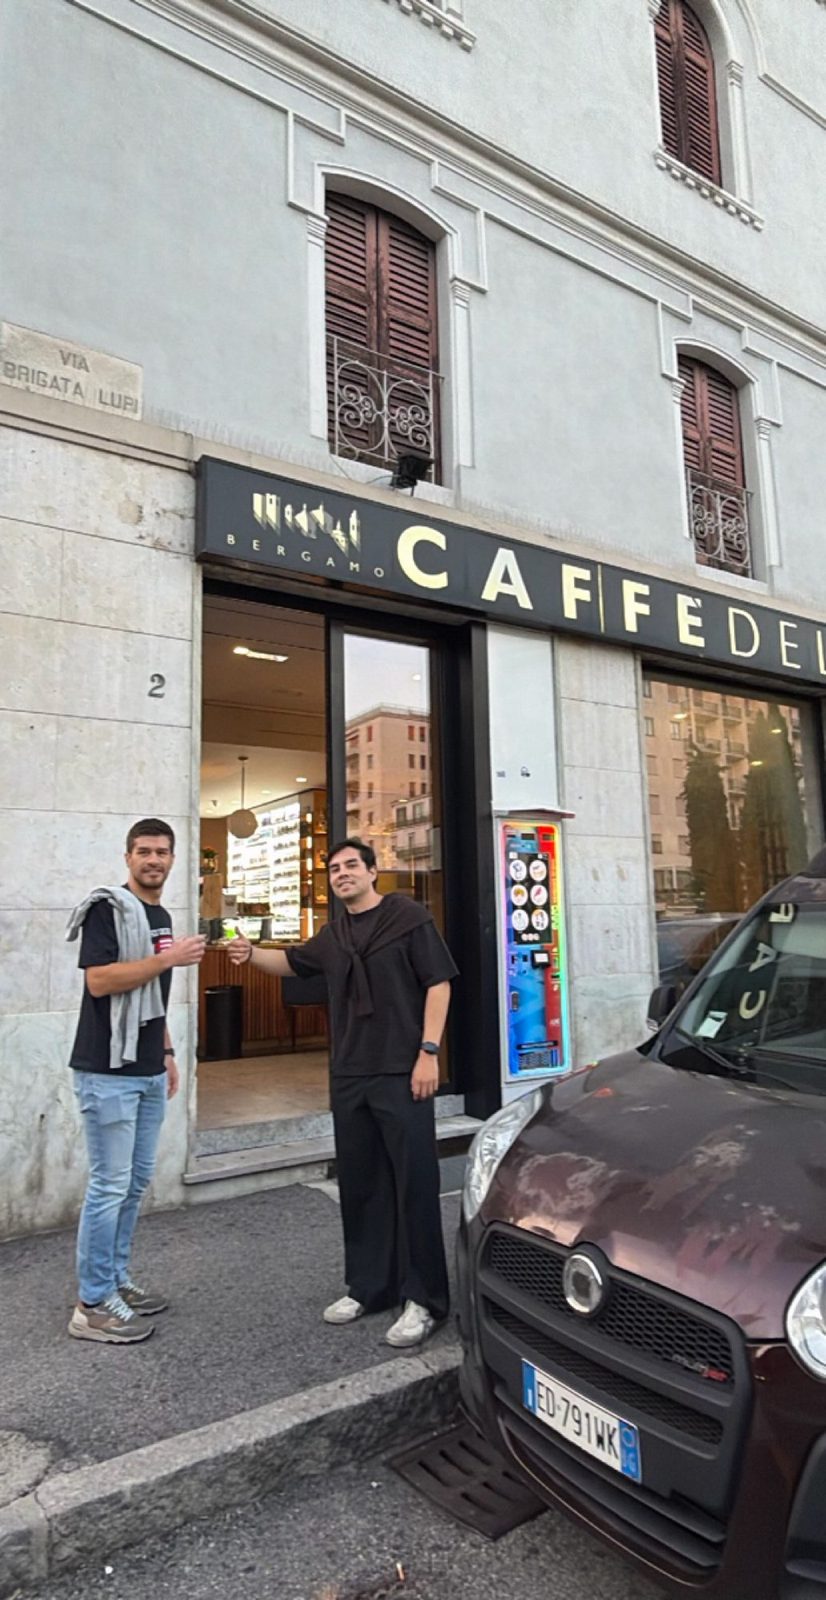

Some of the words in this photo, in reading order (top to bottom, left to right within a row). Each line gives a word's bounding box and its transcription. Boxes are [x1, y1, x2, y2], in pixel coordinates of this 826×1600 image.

[59, 350, 90, 373] VIA
[3, 361, 85, 399] BRIGATA
[98, 388, 139, 414] LUPI
[227, 534, 384, 578] BERGAMO
[147, 673, 166, 699] 2
